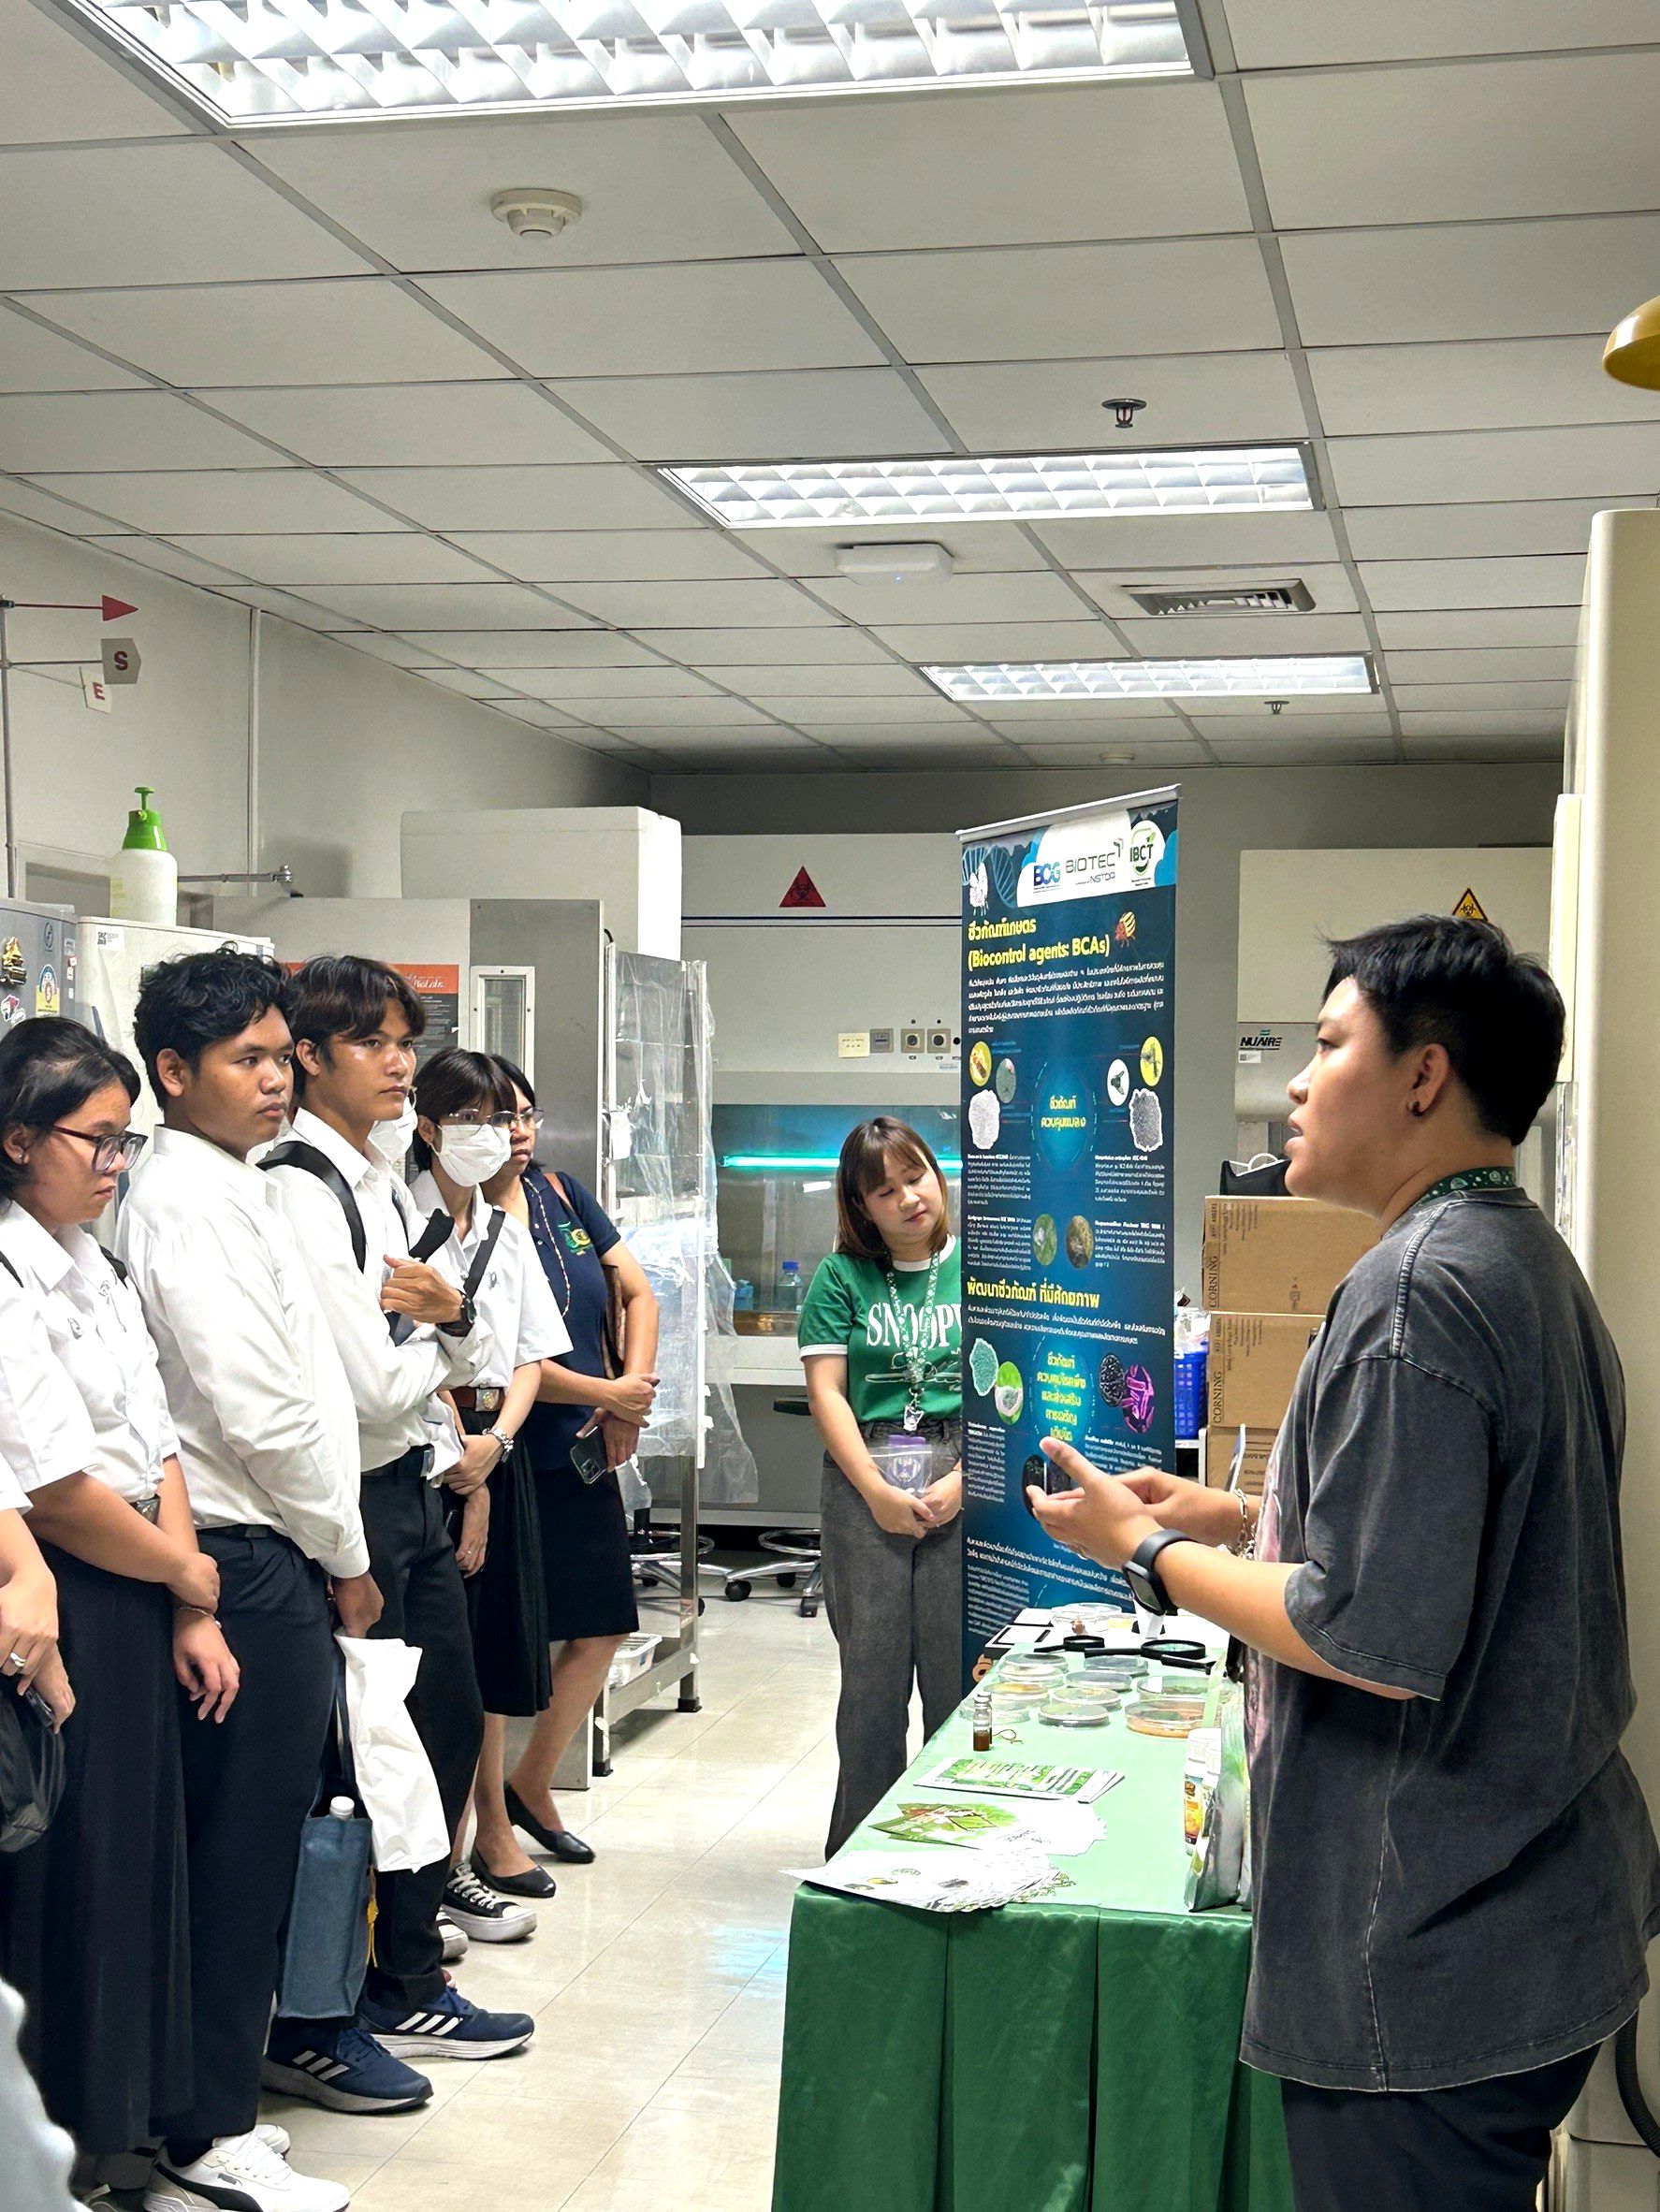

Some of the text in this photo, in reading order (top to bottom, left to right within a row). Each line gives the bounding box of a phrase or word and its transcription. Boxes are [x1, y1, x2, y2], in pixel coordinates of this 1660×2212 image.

[114, 650, 128, 671] S
[93, 682, 105, 701] E
[1065, 851, 1115, 874] BIOTEC
[1129, 843, 1154, 863] IBCT
[968, 934, 1111, 971] (Biocontrol agents: BCAs)
[967, 1275, 1100, 1308] พัฒนาชีวภัณฑ์ ที่มีศักยภาพ
[1209, 1256, 1217, 1308] CORNING
[1213, 1372, 1222, 1424] CORNING
